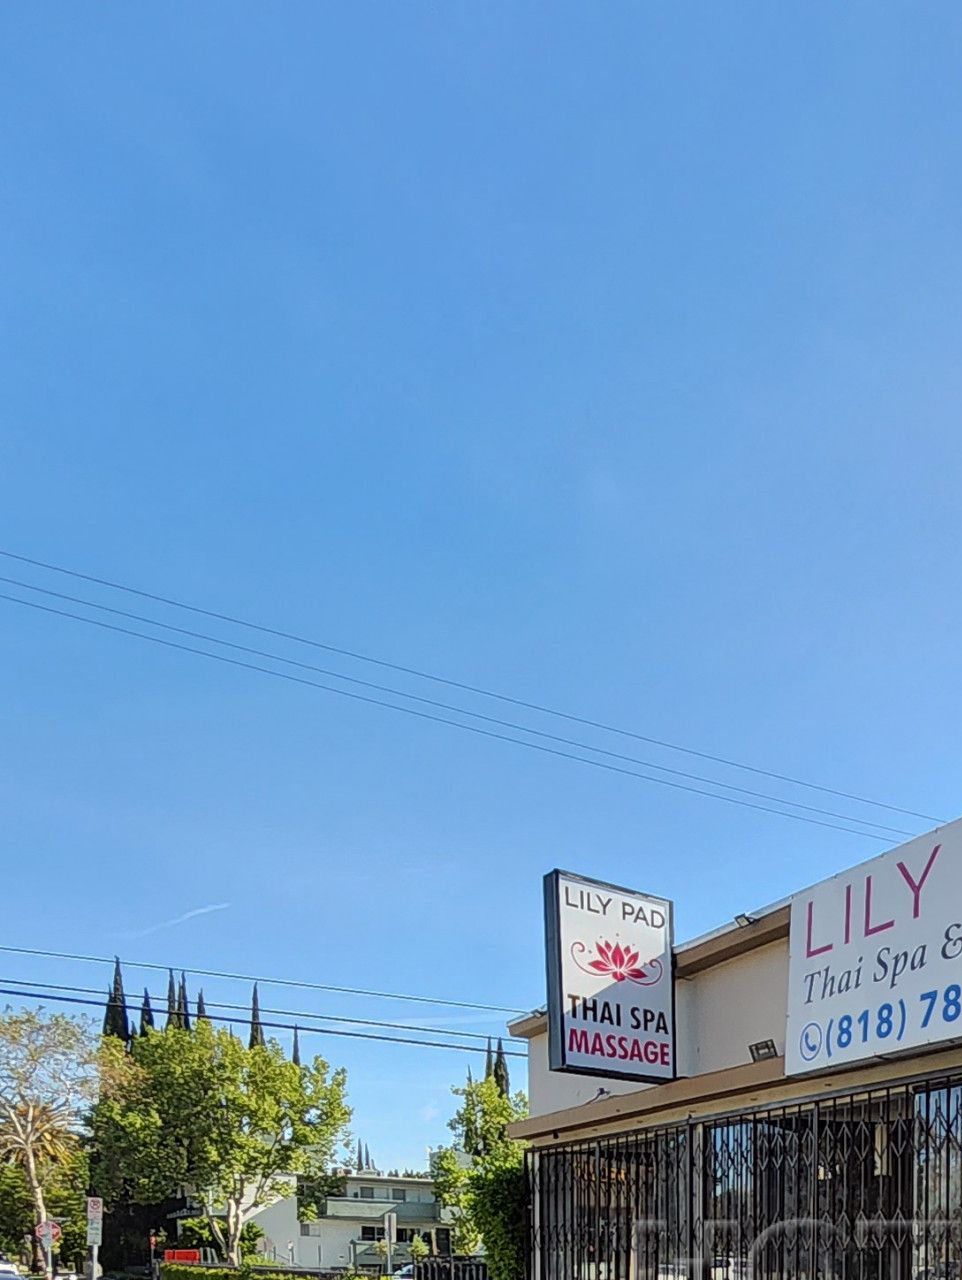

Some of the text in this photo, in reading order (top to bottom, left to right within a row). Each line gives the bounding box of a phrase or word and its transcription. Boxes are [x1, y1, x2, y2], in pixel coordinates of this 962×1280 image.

[564, 886, 666, 930] LILY PAD
[806, 843, 942, 959] LILY
[803, 956, 864, 1004] Thai
[873, 943, 928, 990] Spa
[567, 993, 669, 1035] THAI SPA
[825, 999, 907, 1058] (818)
[568, 1028, 670, 1067] MASSAGE
